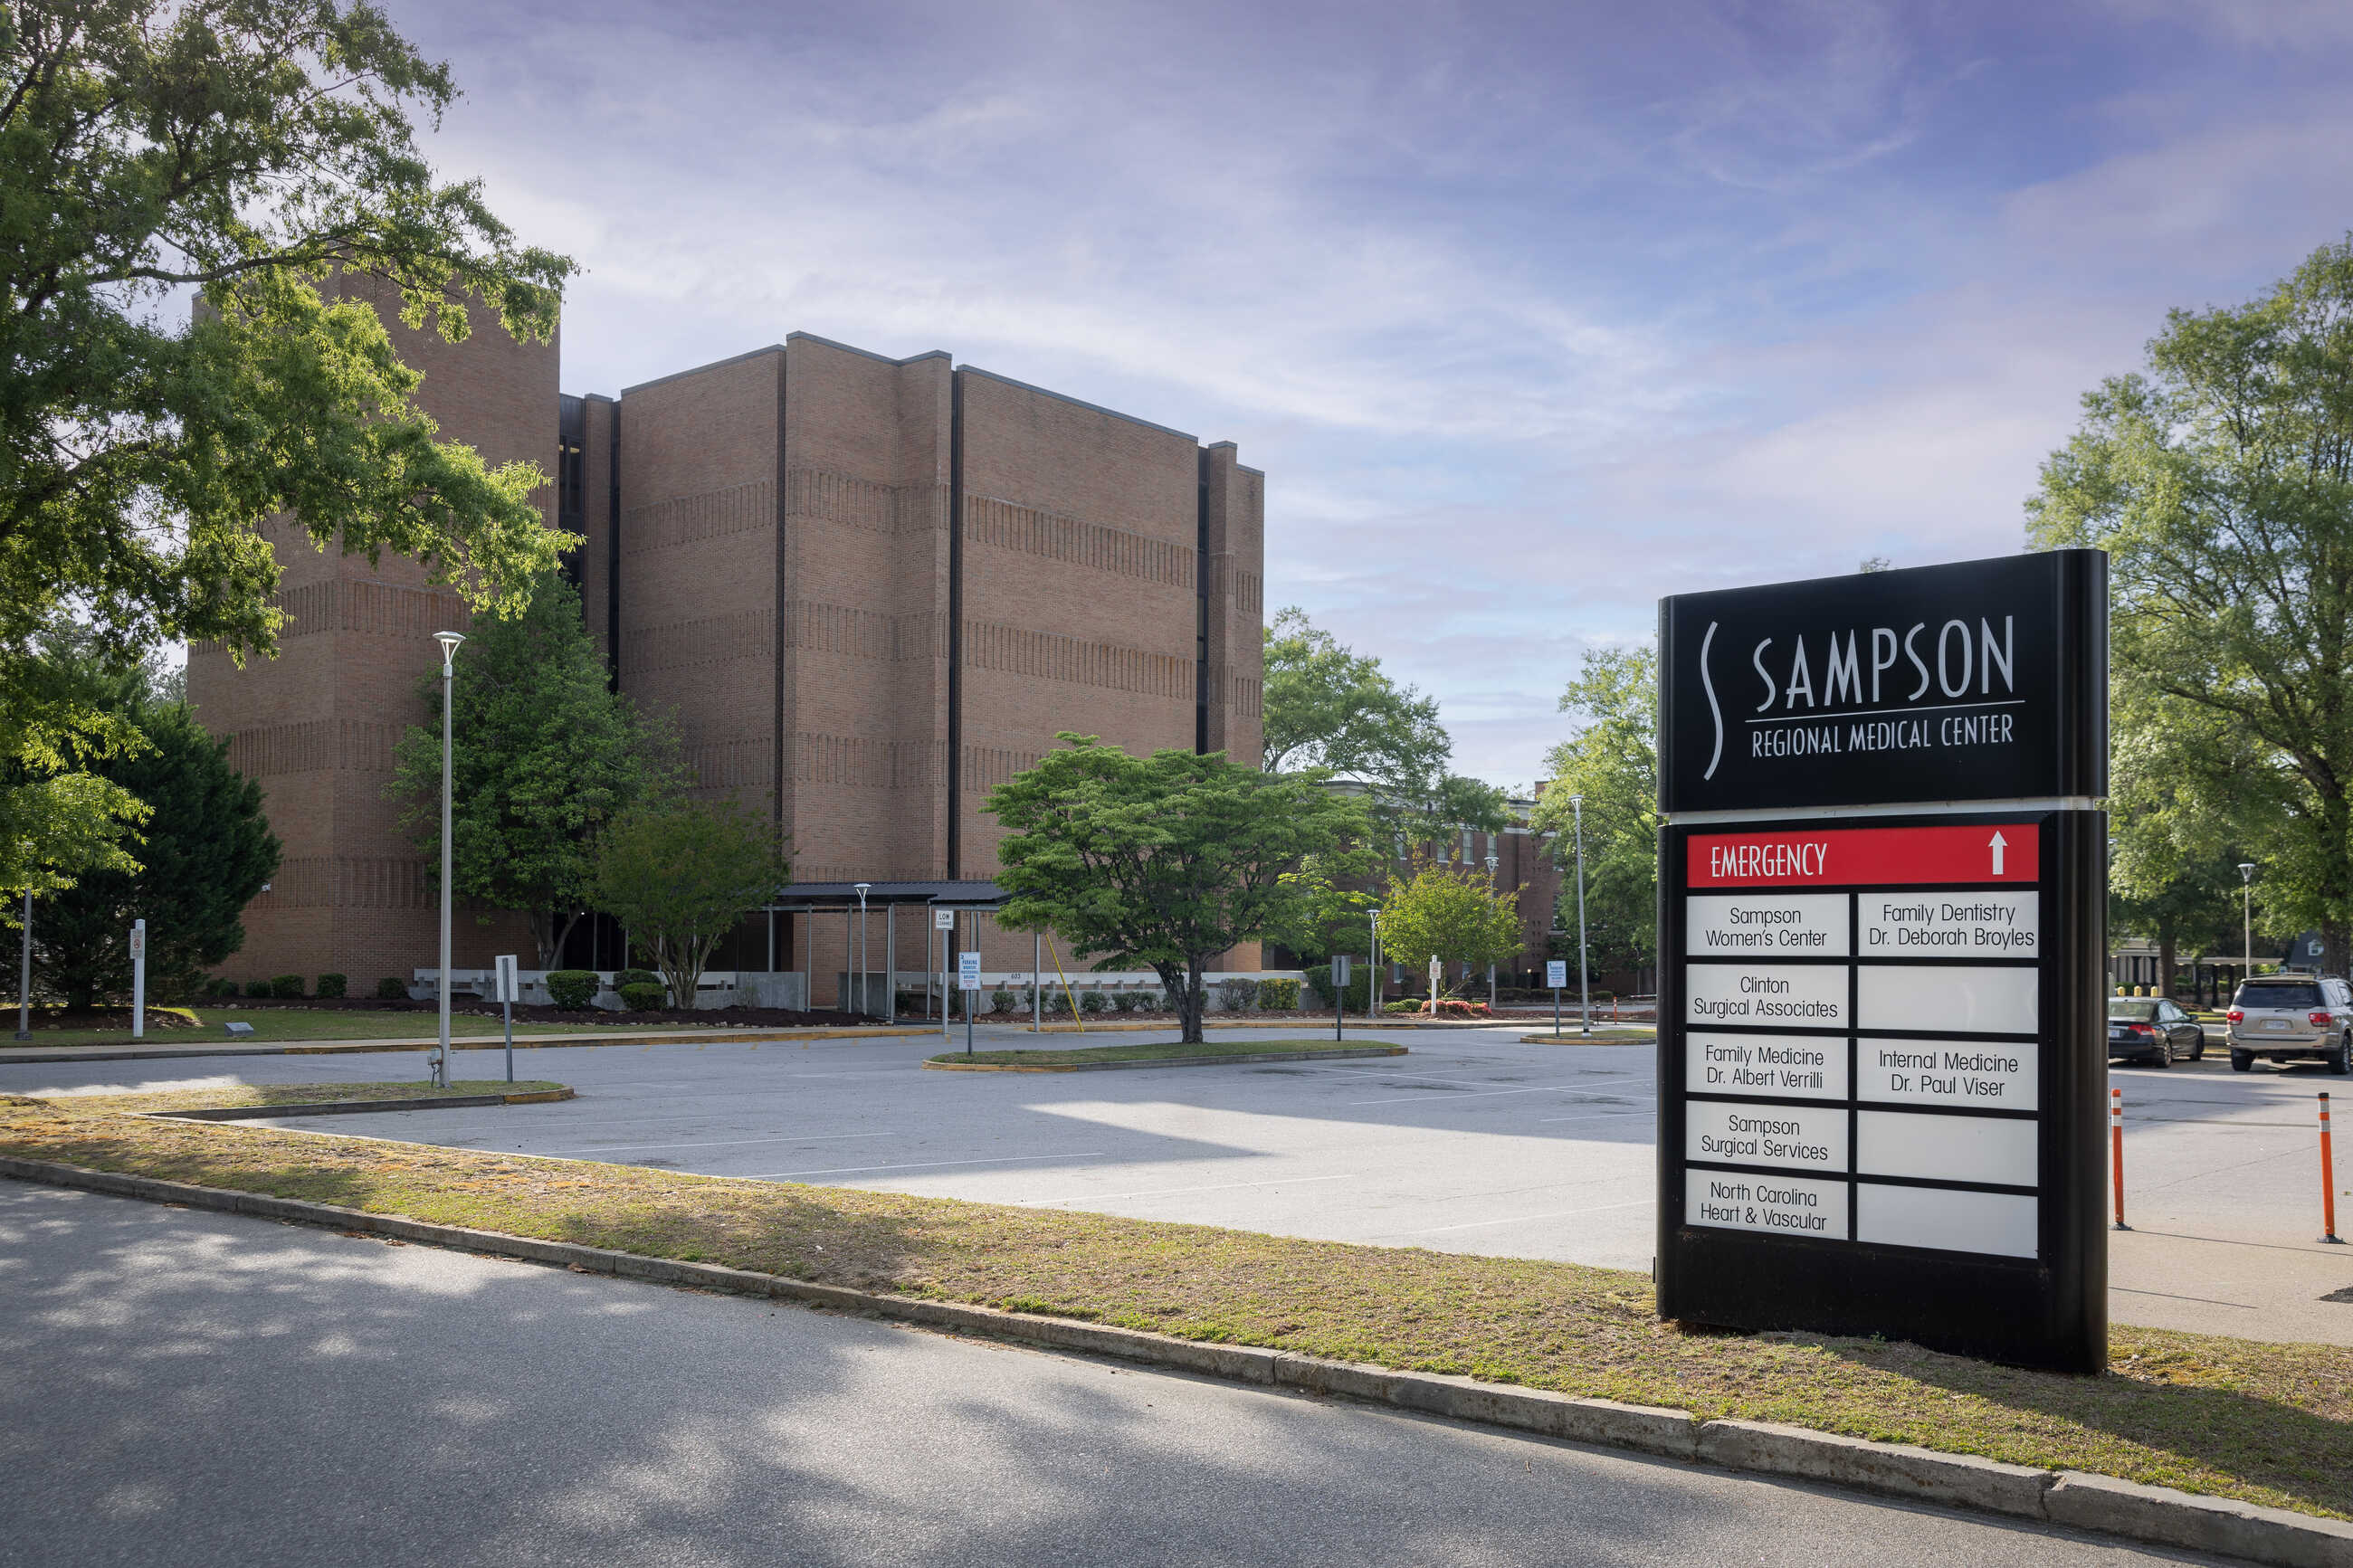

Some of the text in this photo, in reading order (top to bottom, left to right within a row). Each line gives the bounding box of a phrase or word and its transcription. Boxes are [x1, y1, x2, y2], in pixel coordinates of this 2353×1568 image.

[1753, 616, 2014, 713] SAMPSON
[1752, 714, 2014, 758] REGIONAL MEDICAL CENTER
[1710, 843, 1827, 878] EMERGENCY
[1730, 908, 1801, 927] Sampson
[1884, 904, 2015, 926] Family Dentistry
[1706, 929, 1827, 946] Women's Center
[1870, 927, 2034, 950] Dr. Deborah Broyles
[1740, 976, 1788, 993] Clinton
[1694, 998, 1837, 1019] Surgical Associates
[1707, 1045, 1824, 1067] Family Medicine
[1880, 1050, 2018, 1072] Internal Medicine
[1708, 1067, 1822, 1088] Dr. Albert Verrilli
[1892, 1074, 2005, 1096] Dr. Paul Viser
[1729, 1115, 1799, 1137] Sampson
[1702, 1136, 1827, 1160] Surgical Services
[1711, 1182, 1816, 1207] North Carolina
[1701, 1202, 1827, 1231] Heart & Vascular
